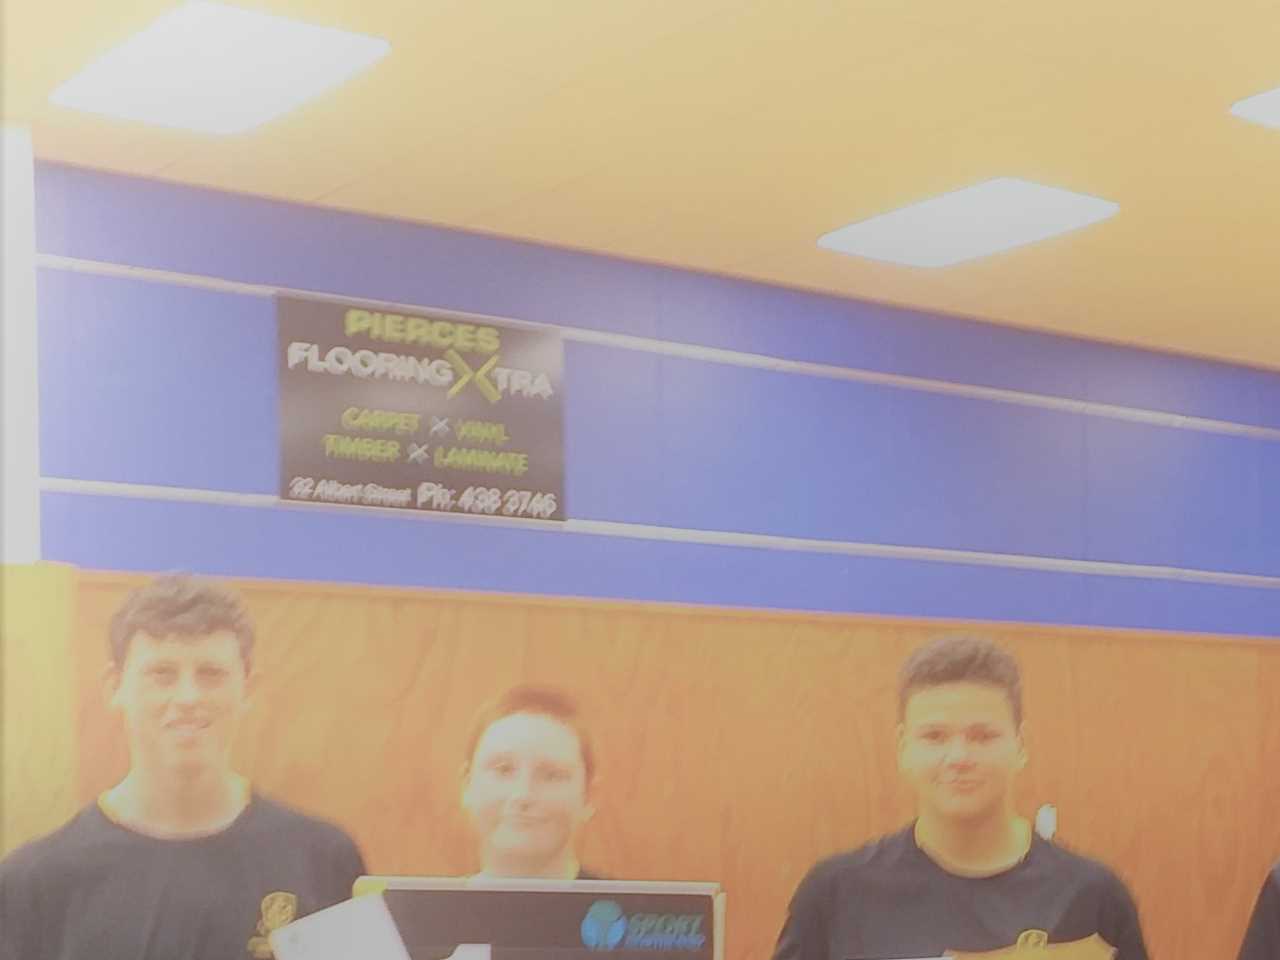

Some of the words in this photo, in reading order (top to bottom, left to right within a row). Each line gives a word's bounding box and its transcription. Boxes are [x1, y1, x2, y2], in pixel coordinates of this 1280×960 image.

[344, 308, 501, 352] PIERCES
[341, 406, 420, 433] CARPET
[321, 433, 400, 462] TIMBER
